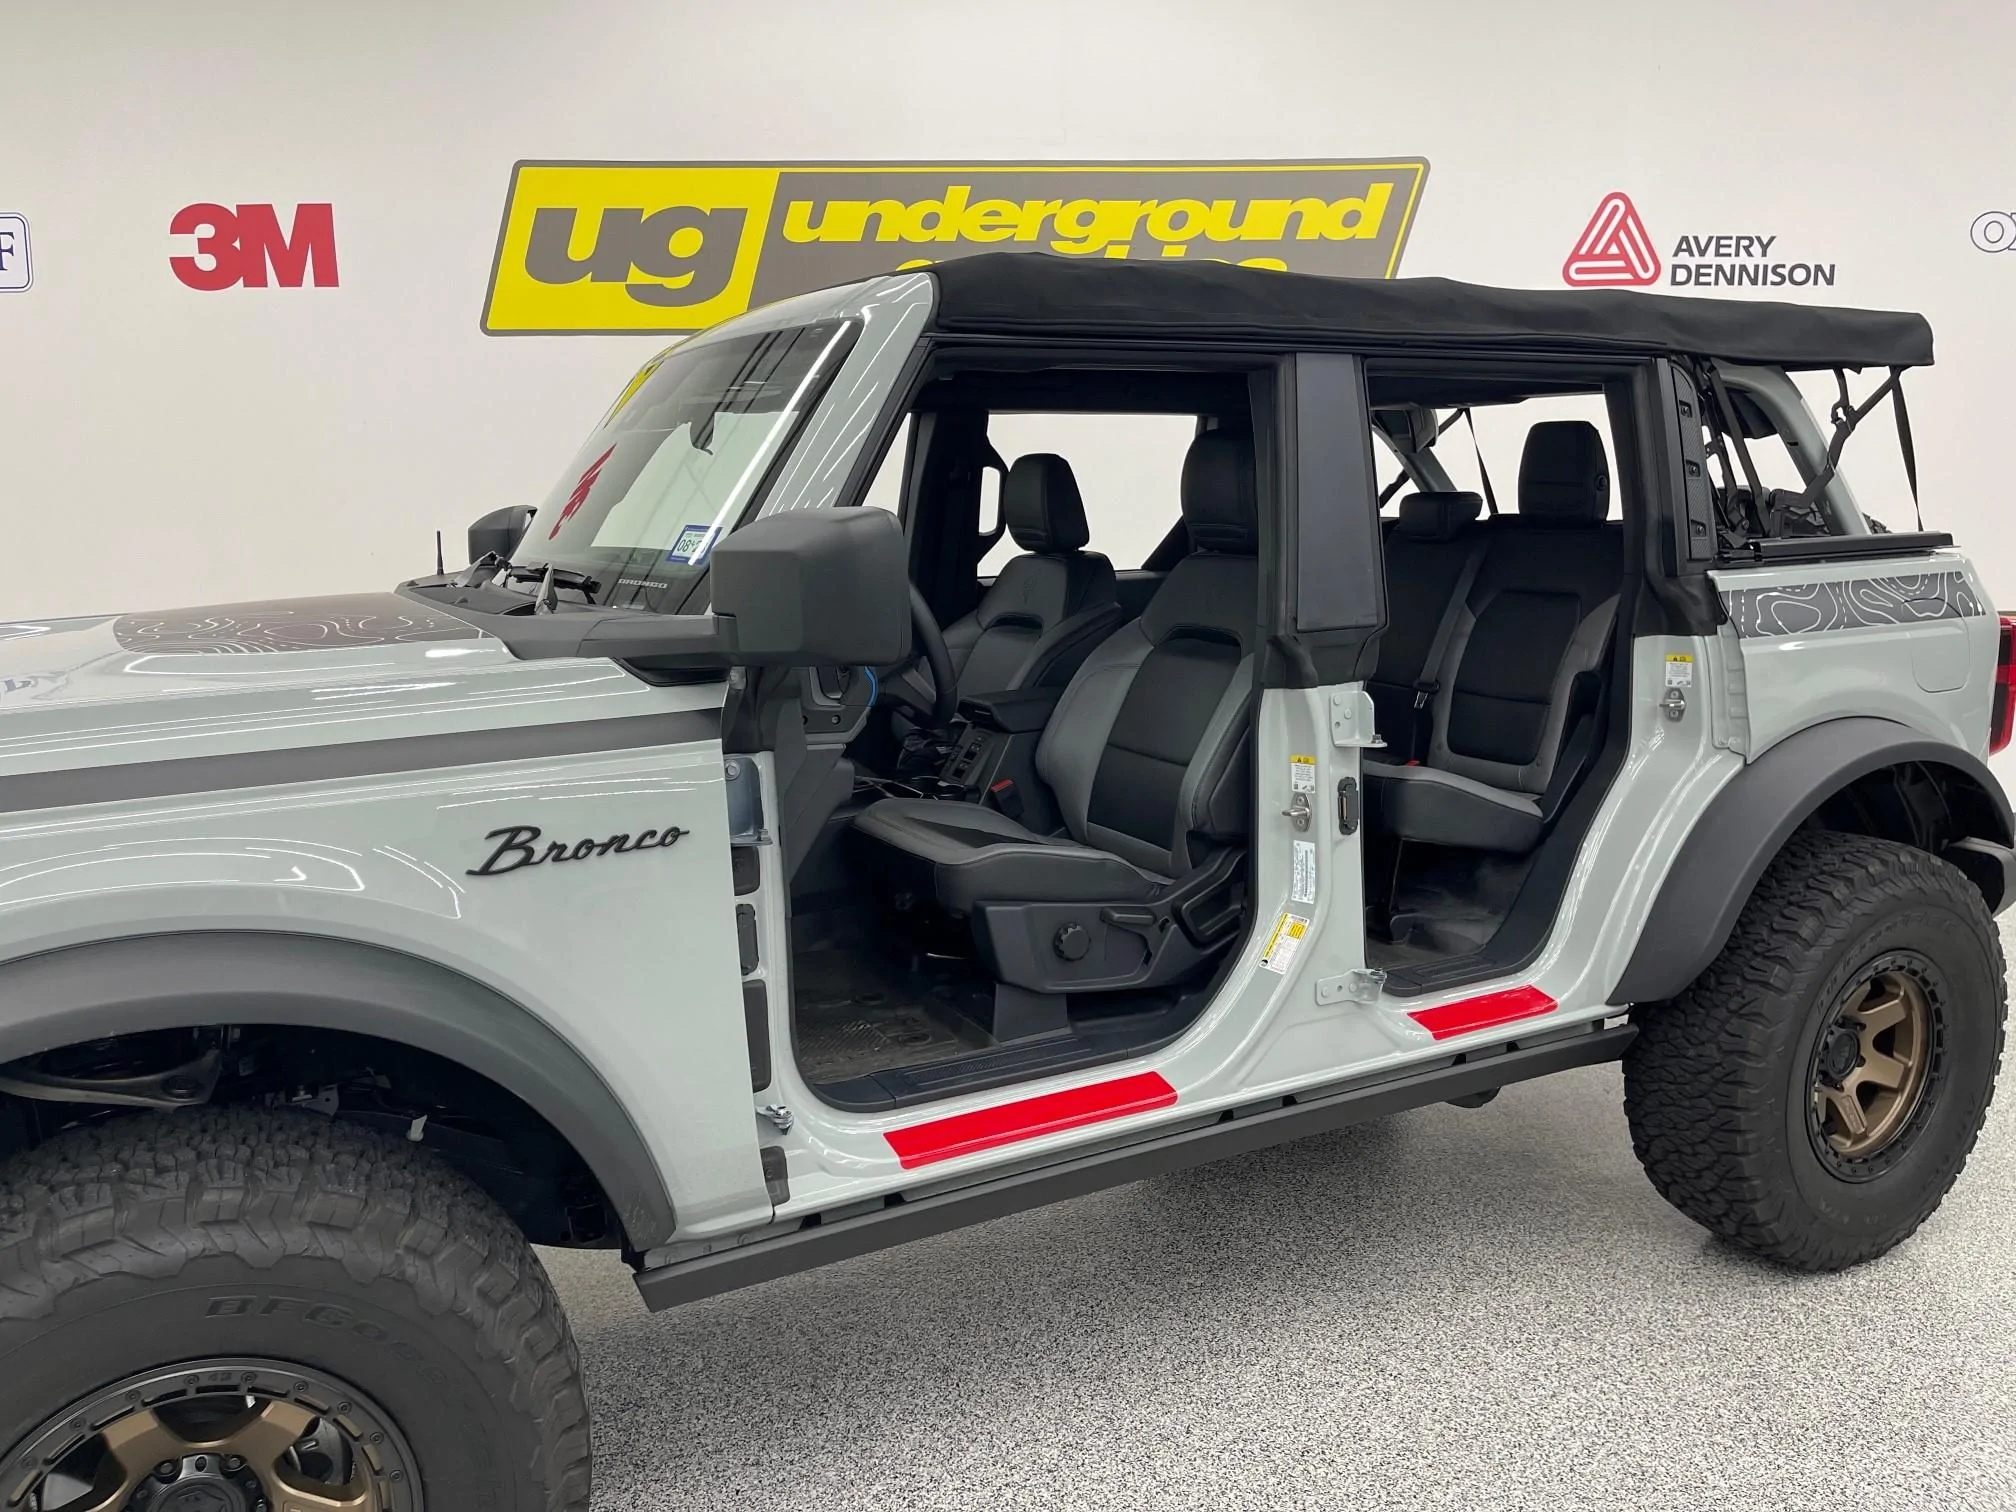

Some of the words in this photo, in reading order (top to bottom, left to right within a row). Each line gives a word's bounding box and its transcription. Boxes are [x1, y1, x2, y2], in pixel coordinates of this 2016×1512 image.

[782, 182, 1394, 255] underground
[1970, 211, 2016, 253] O
[169, 203, 339, 291] 3M
[524, 205, 748, 307] ug
[1672, 235, 1776, 258] AVERY
[1670, 263, 1836, 287] DENNISON
[618, 578, 668, 589] BRONCO
[465, 825, 691, 876] Bronco
